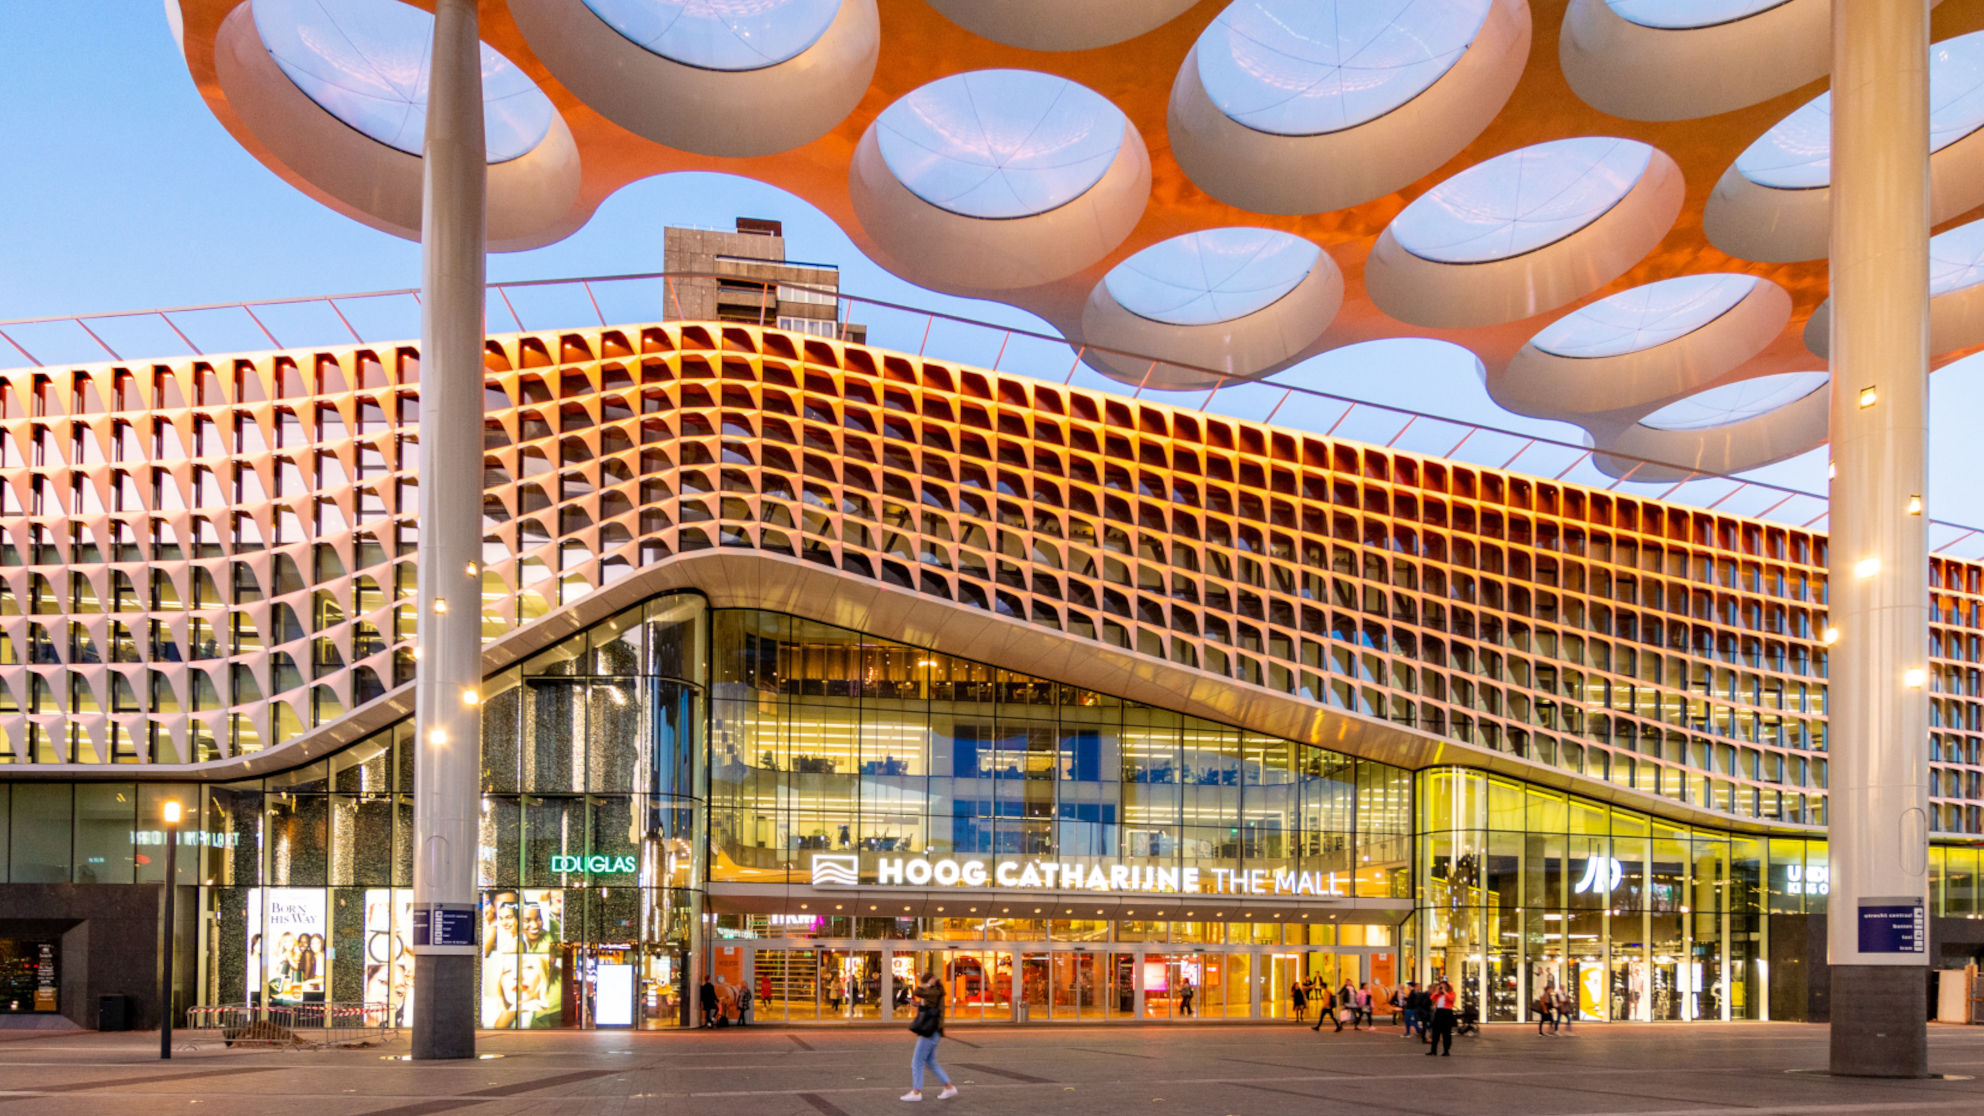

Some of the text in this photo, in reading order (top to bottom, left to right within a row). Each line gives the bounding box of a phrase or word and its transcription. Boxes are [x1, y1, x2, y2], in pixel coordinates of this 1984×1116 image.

[551, 855, 636, 873] DOUGLAS
[878, 858, 1345, 896] HOOG CATHARIJNE THE MALL
[1574, 856, 1623, 894] JD
[272, 902, 307, 916] BORN
[291, 913, 317, 924] WAY
